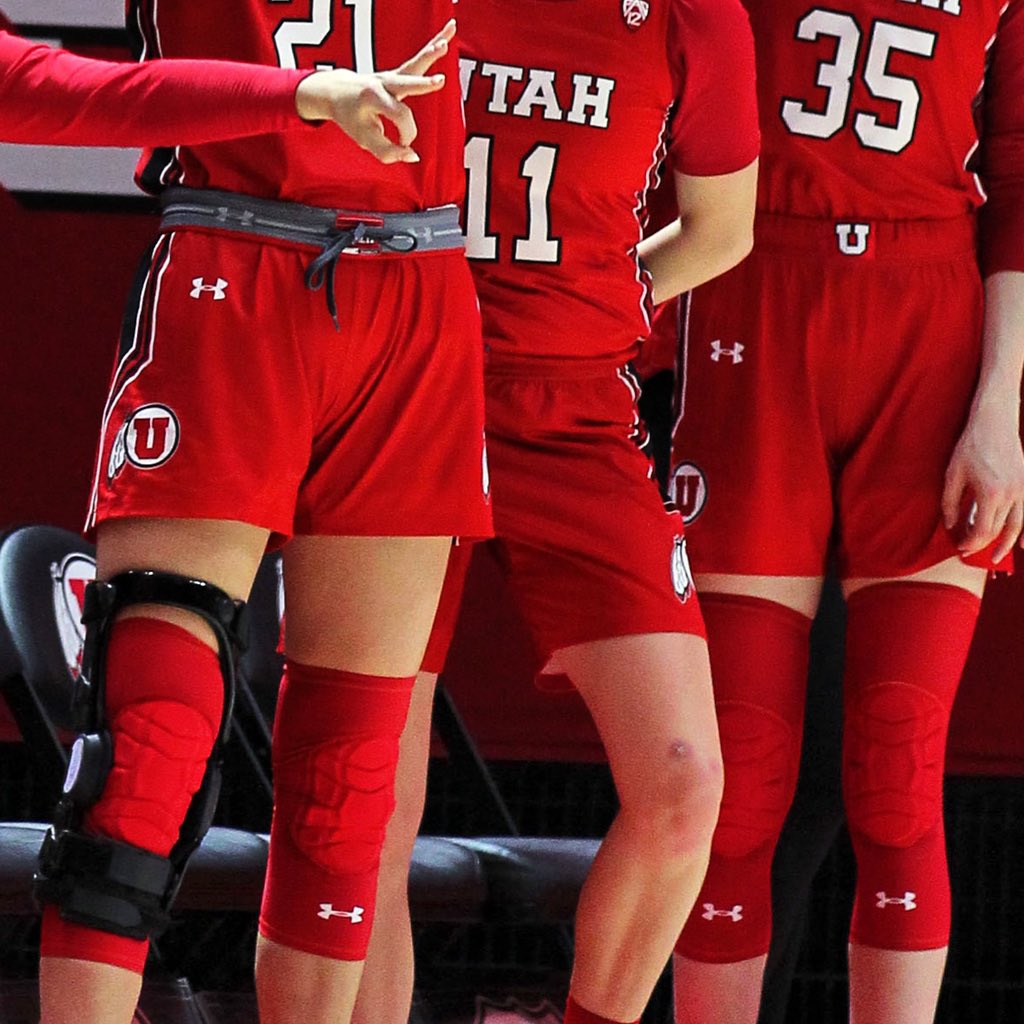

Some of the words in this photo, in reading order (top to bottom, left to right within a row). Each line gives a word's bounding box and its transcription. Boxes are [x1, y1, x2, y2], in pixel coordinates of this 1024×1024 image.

[780, 8, 937, 154] 35
[463, 135, 559, 263] 11
[836, 223, 869, 255] U
[133, 417, 170, 460] U
